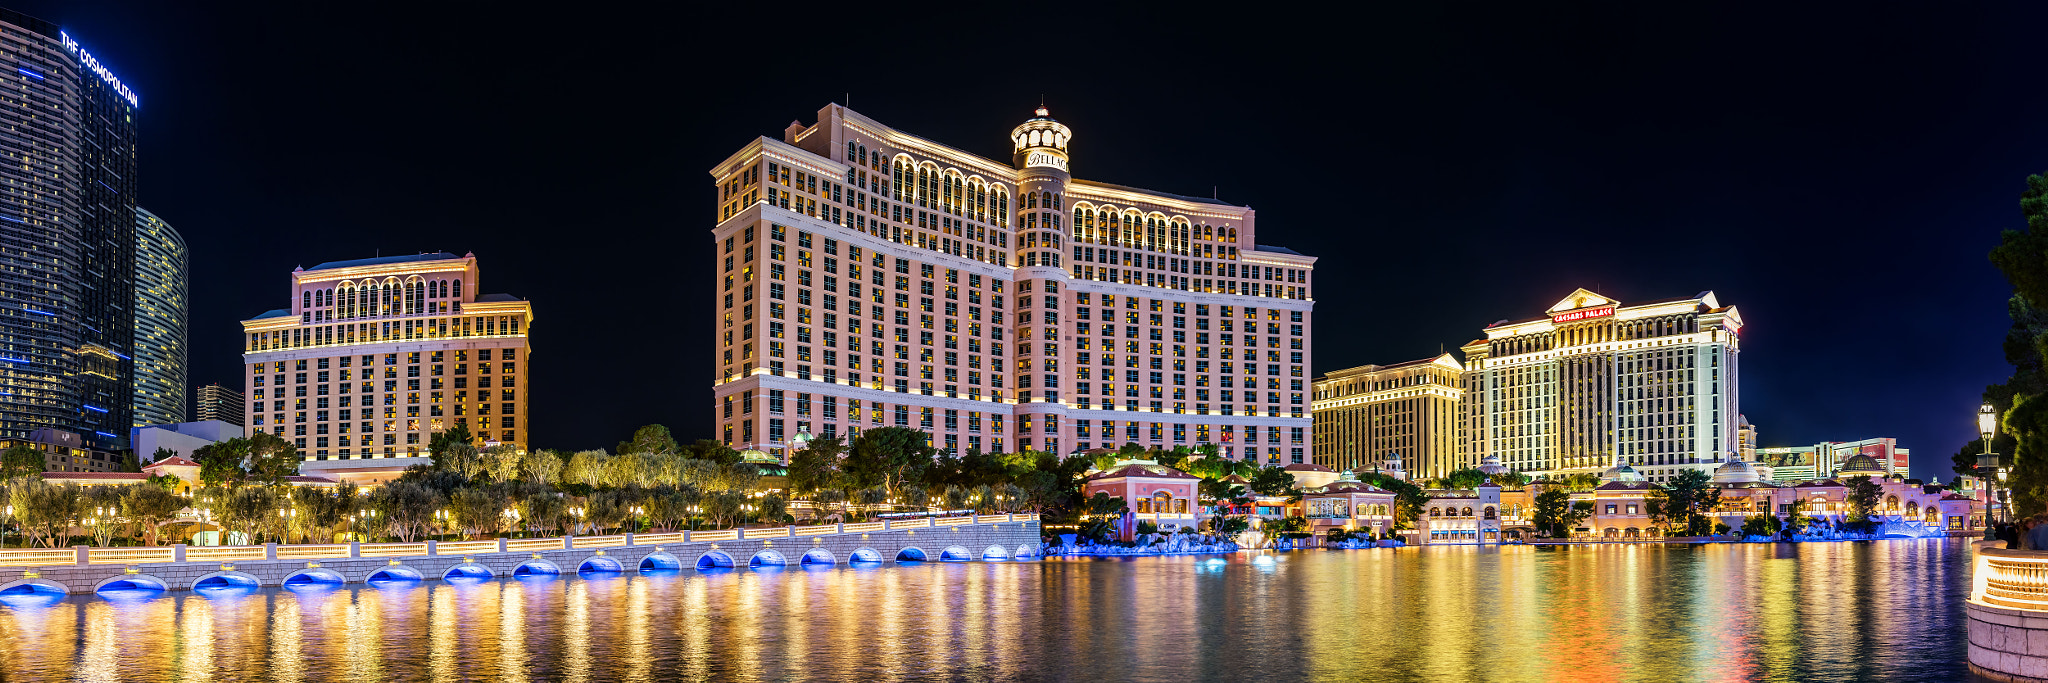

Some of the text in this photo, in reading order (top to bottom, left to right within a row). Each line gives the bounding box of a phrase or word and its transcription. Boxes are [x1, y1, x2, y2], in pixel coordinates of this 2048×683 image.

[80, 48, 137, 108] COSMOPOLITAN
[1555, 308, 1612, 322] CAESARS PALACE
